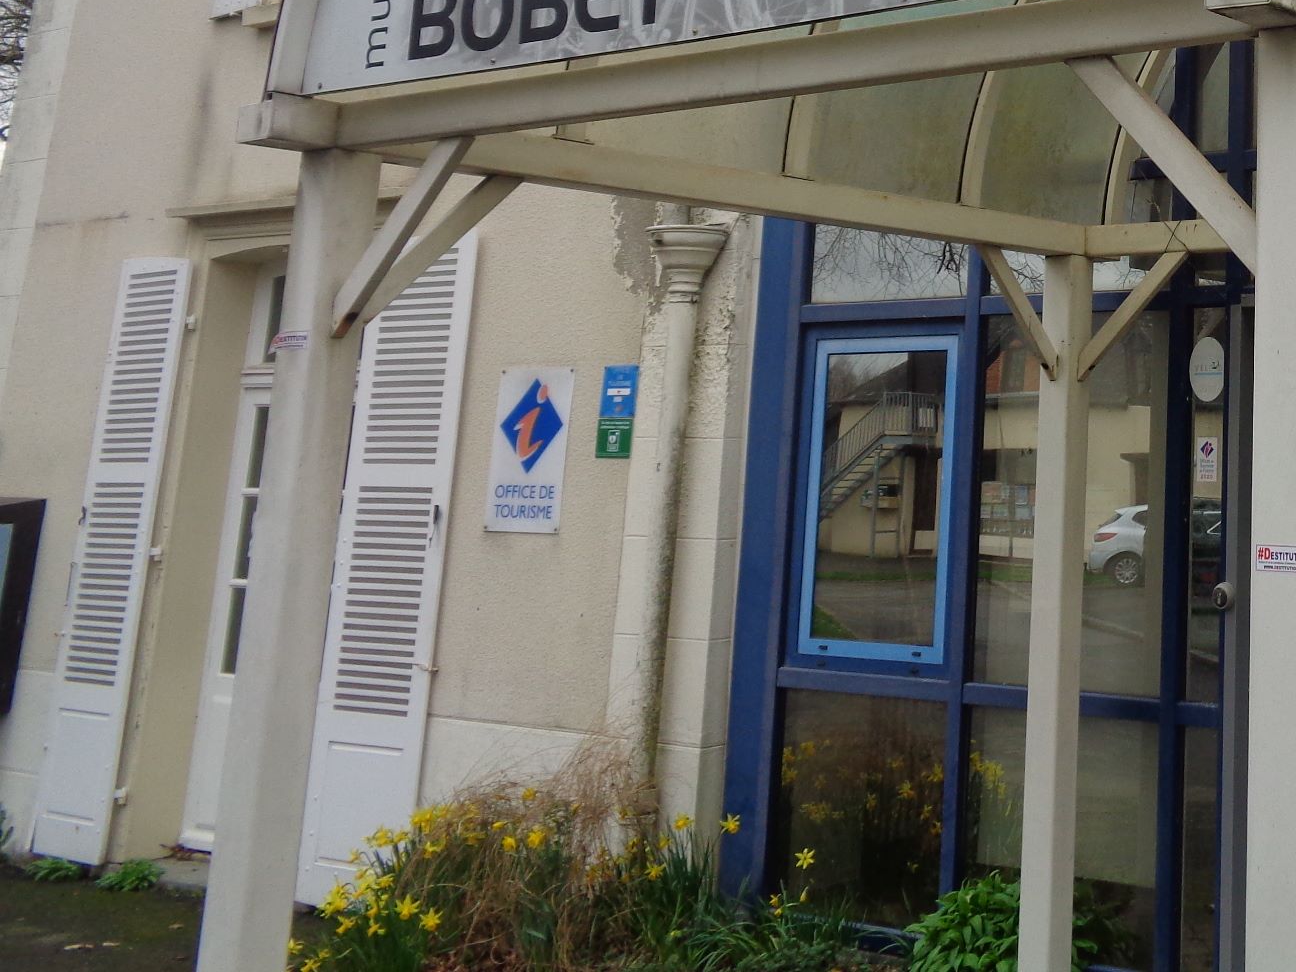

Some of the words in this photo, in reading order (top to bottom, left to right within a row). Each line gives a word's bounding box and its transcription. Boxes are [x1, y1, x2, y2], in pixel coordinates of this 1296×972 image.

[494, 485, 535, 499] OFFICE
[539, 485, 555, 499] DE
[494, 504, 553, 519] TOURISME
